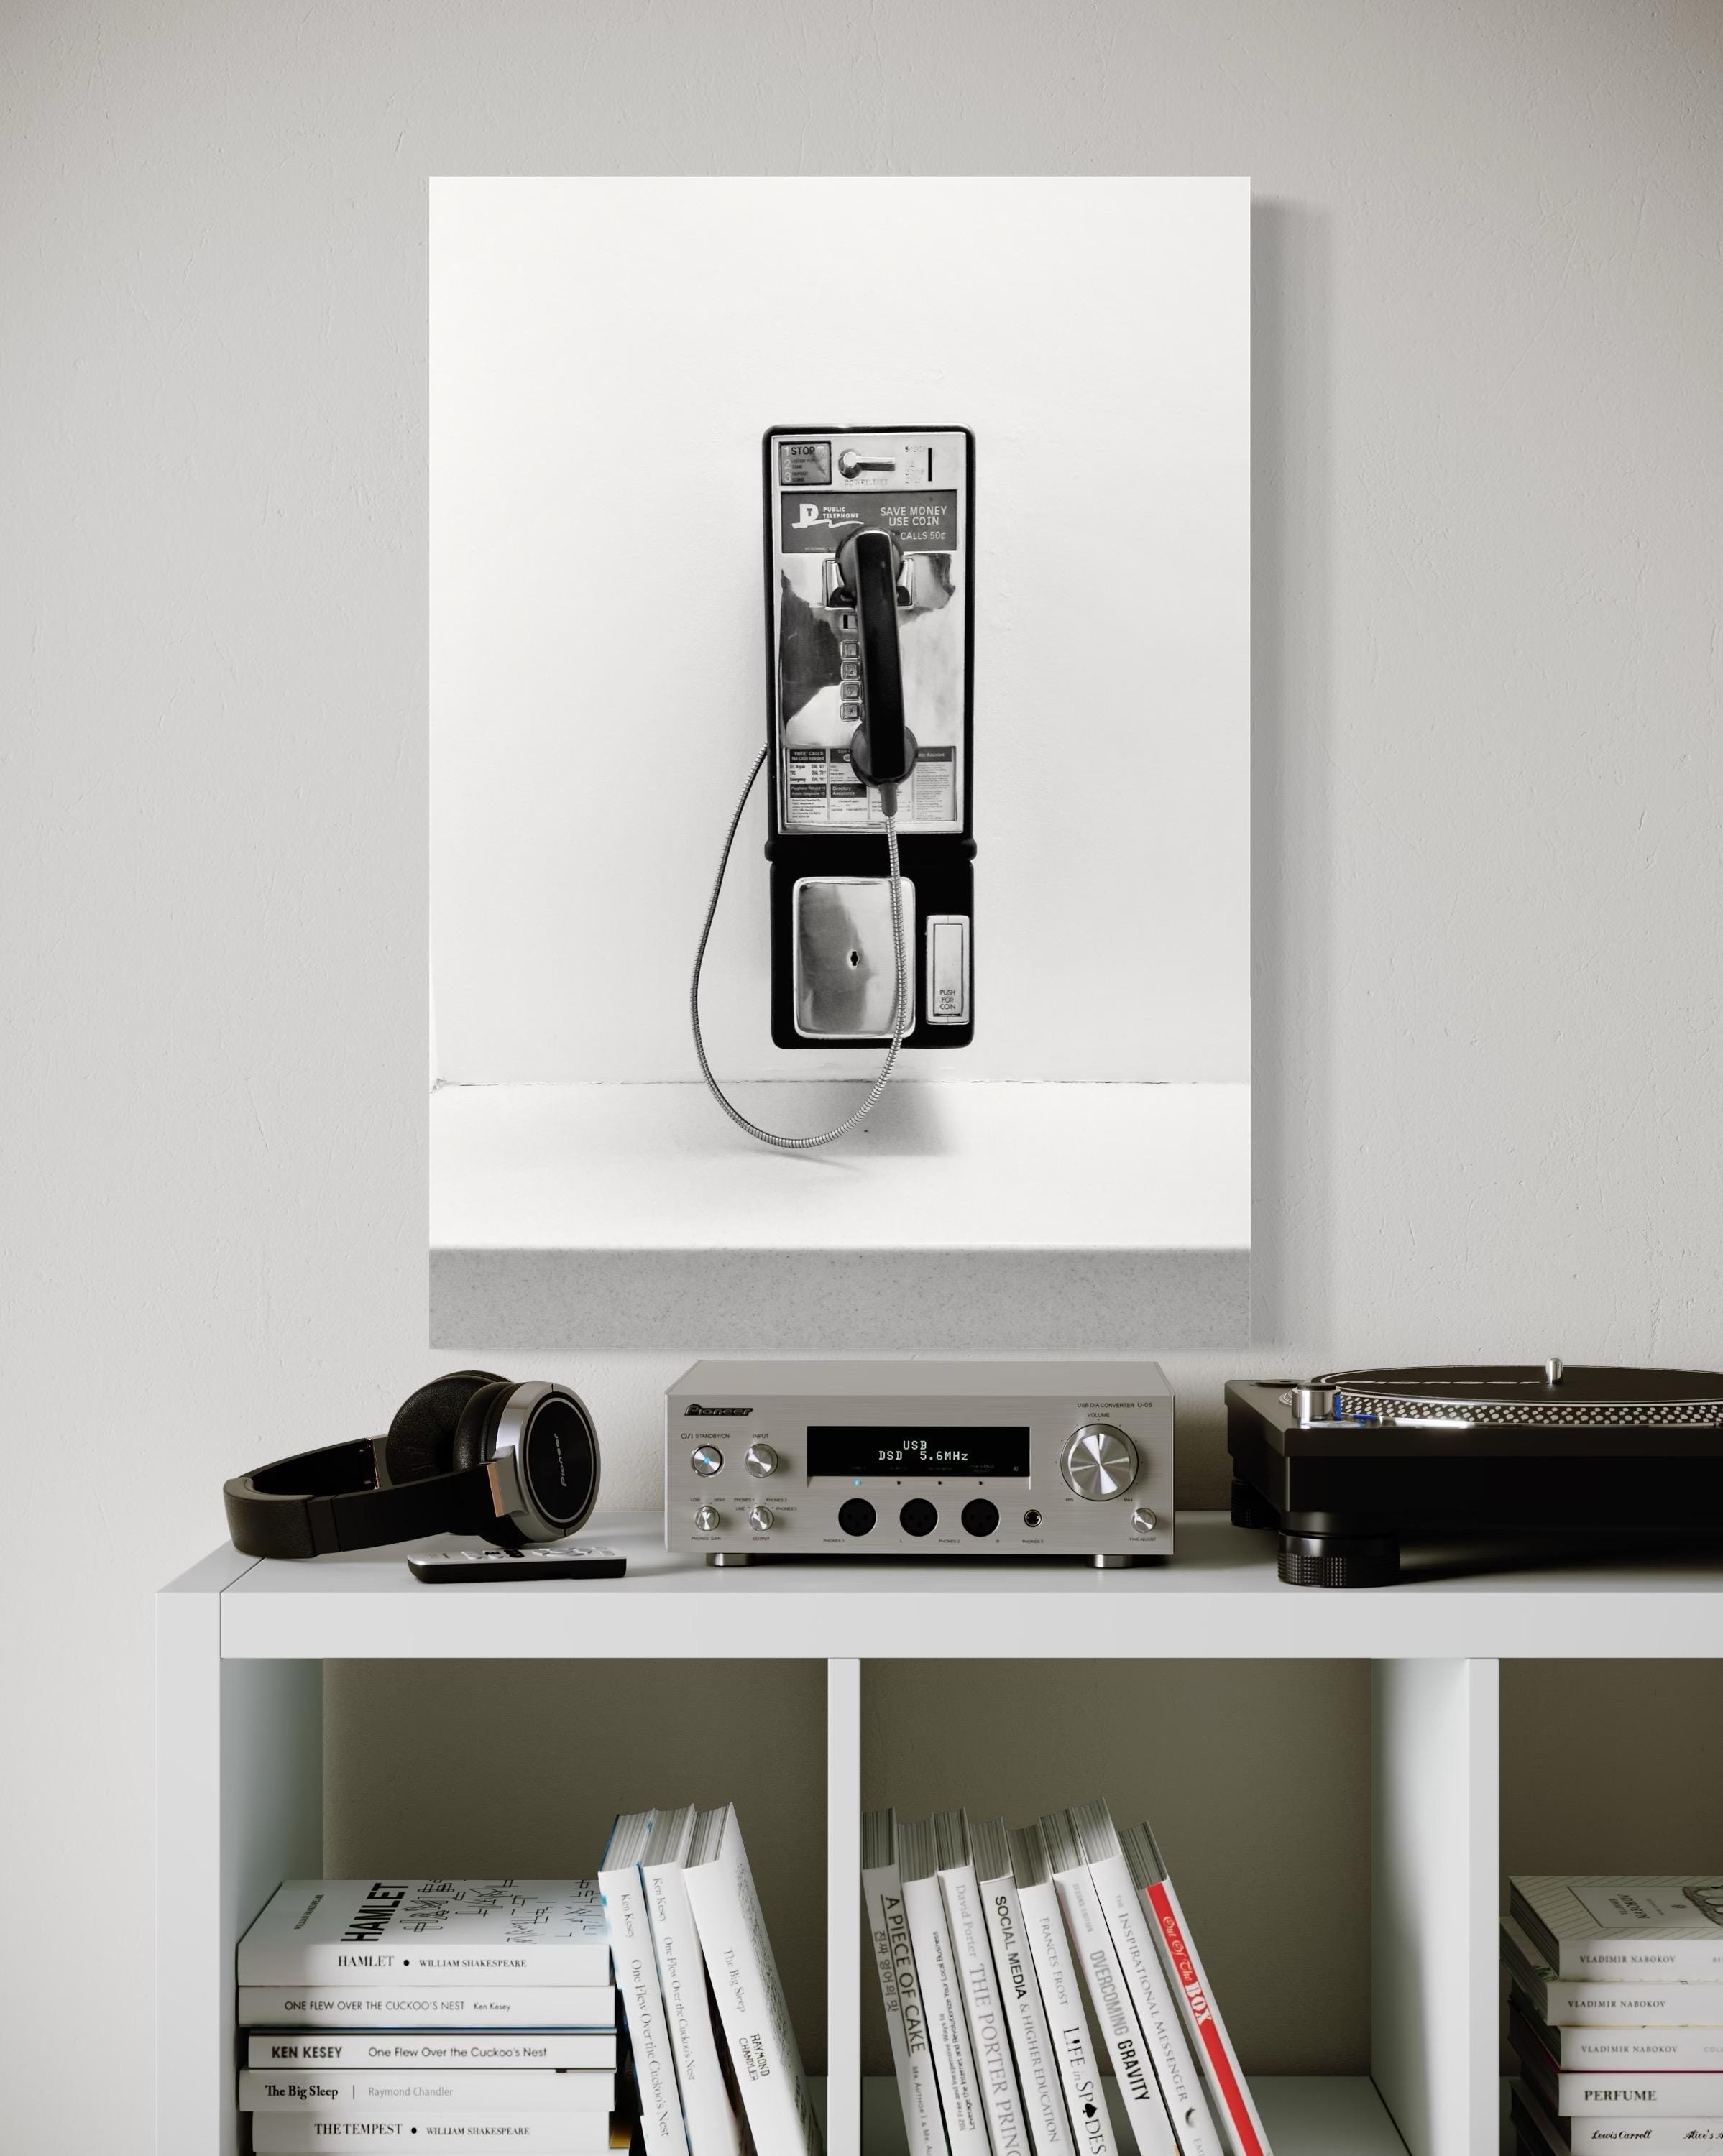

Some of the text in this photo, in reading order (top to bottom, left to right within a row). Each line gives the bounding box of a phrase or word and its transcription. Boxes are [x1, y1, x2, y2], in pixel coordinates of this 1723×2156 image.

[784, 446, 815, 456] 1 STOP
[784, 459, 791, 469] 2
[784, 471, 791, 482] 3
[880, 505, 947, 516] SAVE MONEY
[888, 516, 939, 526] USE COIN
[900, 531, 927, 540] CALLS
[685, 1404, 753, 1416] Pioneer
[903, 1440, 927, 1450] USB
[878, 1450, 968, 1461] DSD 5.6MHz
[653, 1877, 667, 1922] Ken Kesey
[341, 1882, 408, 1942] HAMLET
[621, 1894, 635, 1938] Ken Kesey
[664, 1937, 673, 1955] One
[874, 1930, 889, 1954] 진짜
[932, 1931, 943, 1962] Business
[338, 1955, 527, 1968] HAMLET WILLIAM SHAKESPEARE
[667, 1957, 678, 1977] Flew
[1039, 1917, 1069, 2006] FRANCES FROST
[1579, 1955, 1676, 1963] VLADIMIR NABOKOV
[632, 1959, 643, 1982] One
[885, 1897, 926, 2053] A PIECE OF CAKE
[937, 1963, 947, 1982] Local
[1162, 1916, 1213, 2026] Out Of The BOX
[724, 1948, 746, 2012] The Big Sleep
[635, 1984, 647, 2011] Flew
[671, 1980, 681, 2002] Over
[956, 1884, 1008, 2095] David Porter THE PORTER
[284, 2000, 465, 2011] ONE FLEW OVER THE CUCKOO'S NEST
[473, 2001, 511, 2013] Ken Kesey
[675, 2003, 685, 2017] the
[1118, 1912, 1160, 2018] INSPIRATIONAL
[1154, 2020, 1189, 2103] MESSENGER
[1568, 2000, 1667, 2009] VLADIMIR NABOKOV
[641, 2013, 653, 2040] Over
[946, 1998, 958, 2043] Revolutionize
[995, 1896, 1059, 2143] SOCIAL MEDIA & HIGHER EDUCATION
[1090, 1950, 1150, 2101] OVERCOMING GRAVITY
[271, 2045, 343, 2059] KEN KESEY
[367, 2046, 547, 2058] One Flew Over the Cuckoo's Nest
[645, 2040, 656, 2058] the
[750, 2033, 771, 2076] RAYMOND
[953, 2043, 962, 2057] and
[1632, 2045, 1679, 2053] NABOKOV
[739, 2037, 760, 2081] CHANDLER
[945, 2043, 957, 2086] Inexpensive
[685, 2060, 695, 2081] Nest
[957, 2058, 967, 2086] Internet
[265, 2084, 339, 2101] The Big Sleep
[367, 2086, 454, 2099] Raymond Chandler
[952, 2086, 960, 2099] and
[1584, 2089, 1658, 2102] PERFUME
[656, 2111, 669, 2137] Nest
[965, 2099, 975, 2131] Leverage
[314, 2122, 530, 2136] THE TEMPEST WILLIAM SHAKESPEARE
[1591, 2129, 1714, 2139] Lewis Carroll Alice's
